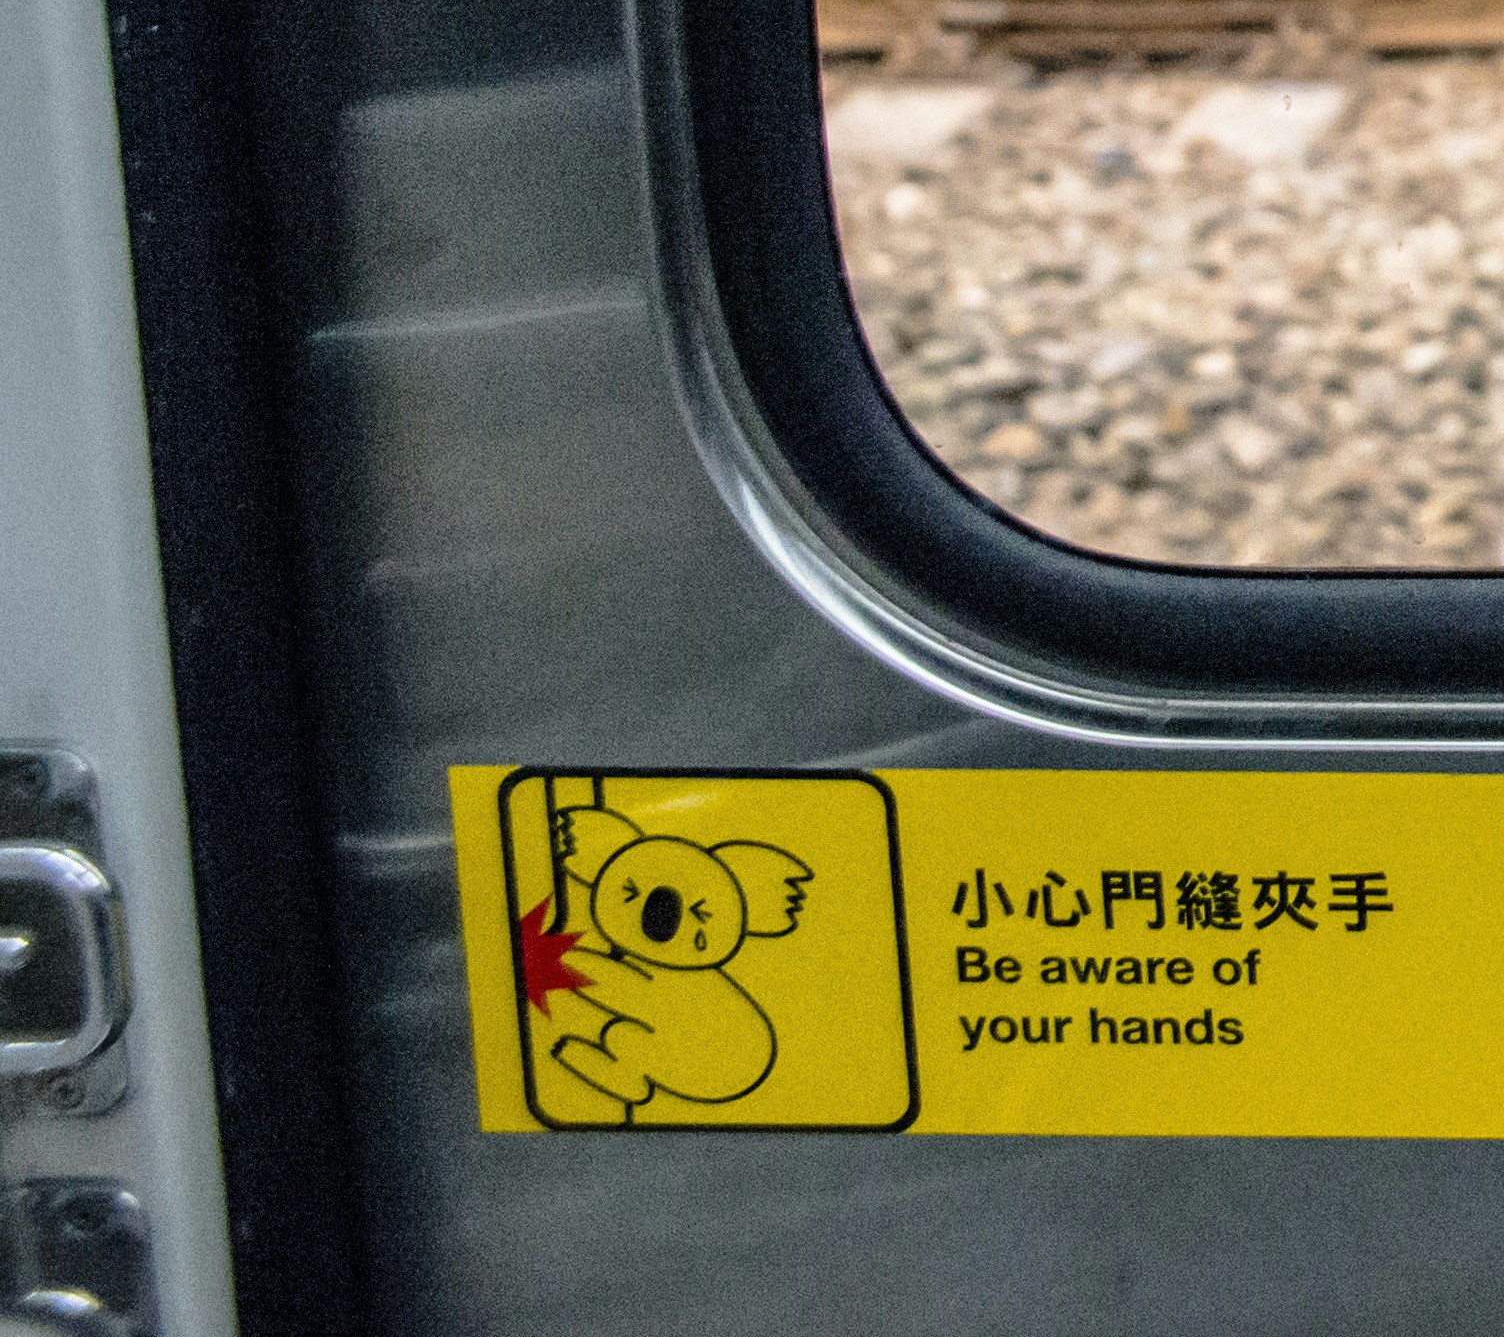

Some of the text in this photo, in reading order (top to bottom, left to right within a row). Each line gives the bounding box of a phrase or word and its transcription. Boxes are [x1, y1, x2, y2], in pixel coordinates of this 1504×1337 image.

[951, 868, 1394, 933] 小心門縫夾手
[955, 946, 1260, 987] Be aware of
[959, 1007, 1244, 1052] your hands
